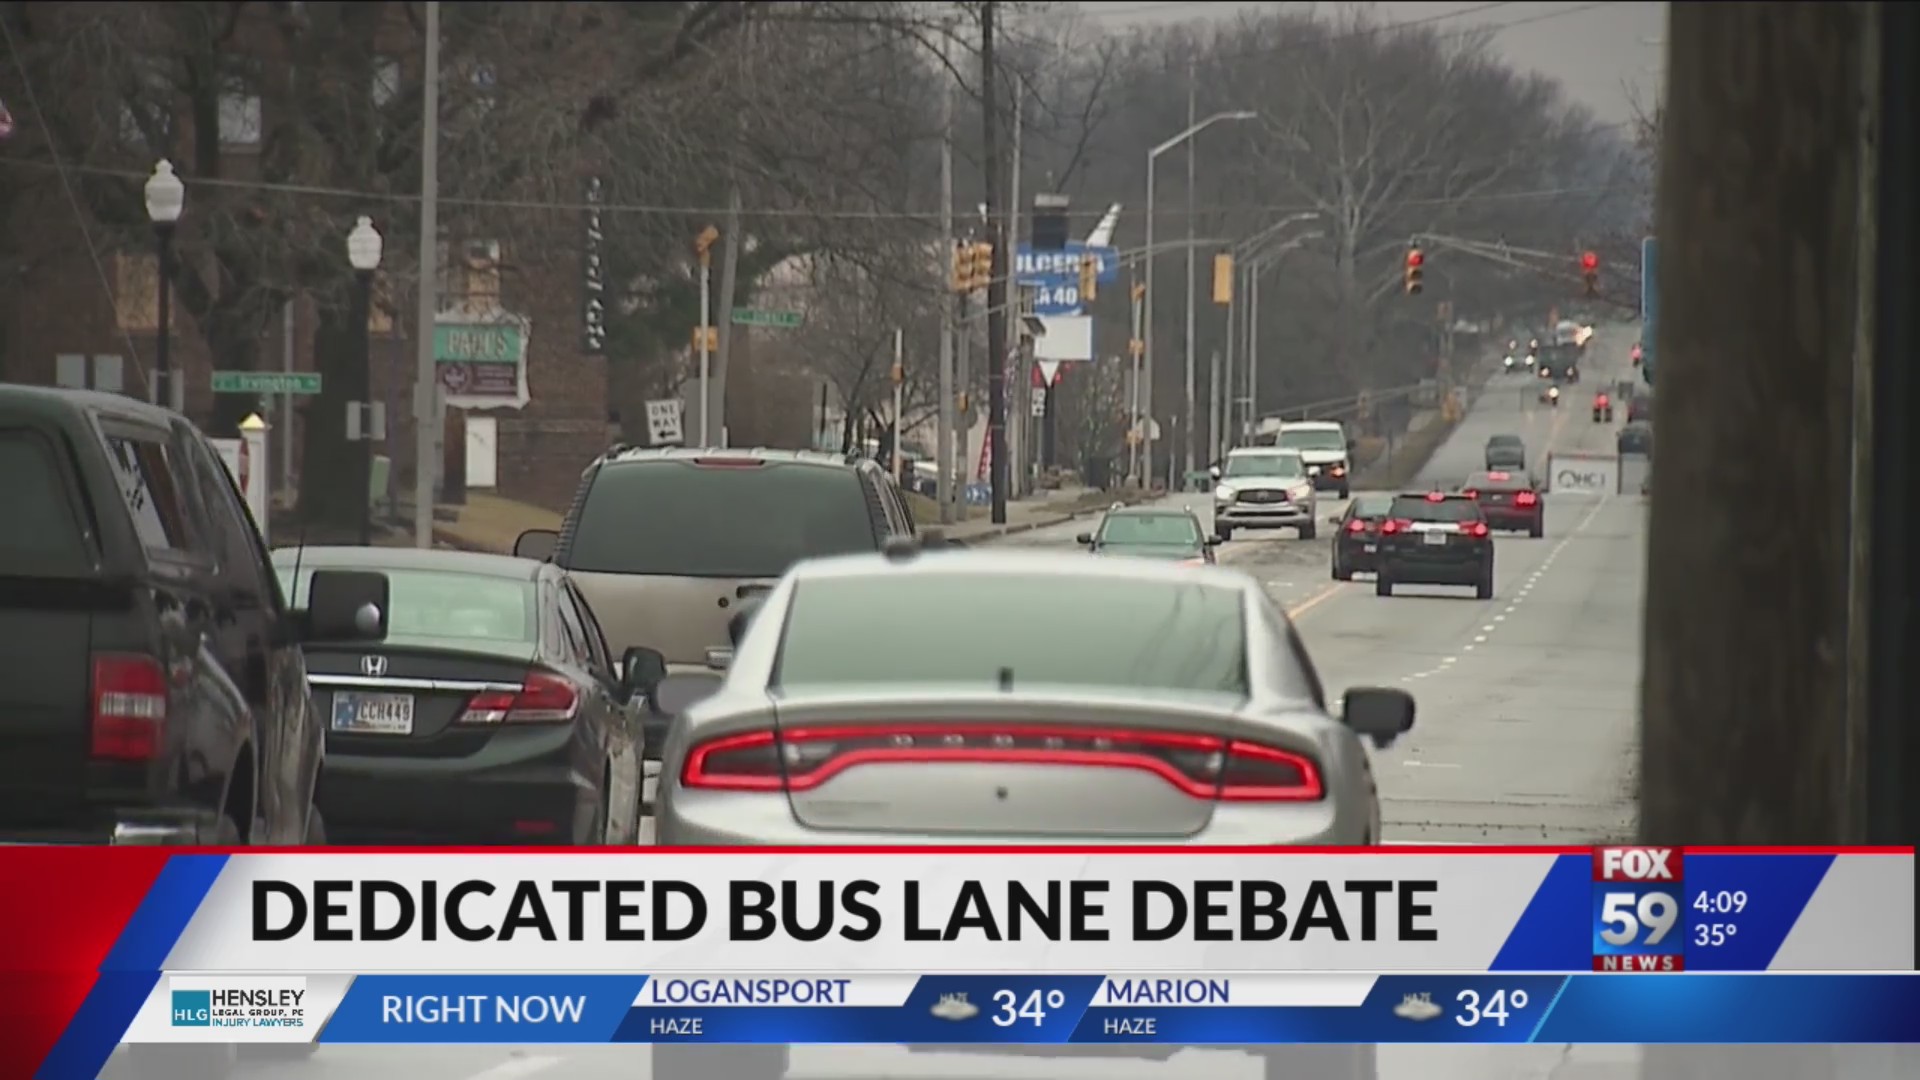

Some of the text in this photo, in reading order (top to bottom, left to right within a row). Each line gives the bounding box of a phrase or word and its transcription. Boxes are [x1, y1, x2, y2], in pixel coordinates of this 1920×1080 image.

[1053, 286, 1078, 305] 40
[651, 404, 677, 416] ONE
[652, 416, 678, 428] WAY
